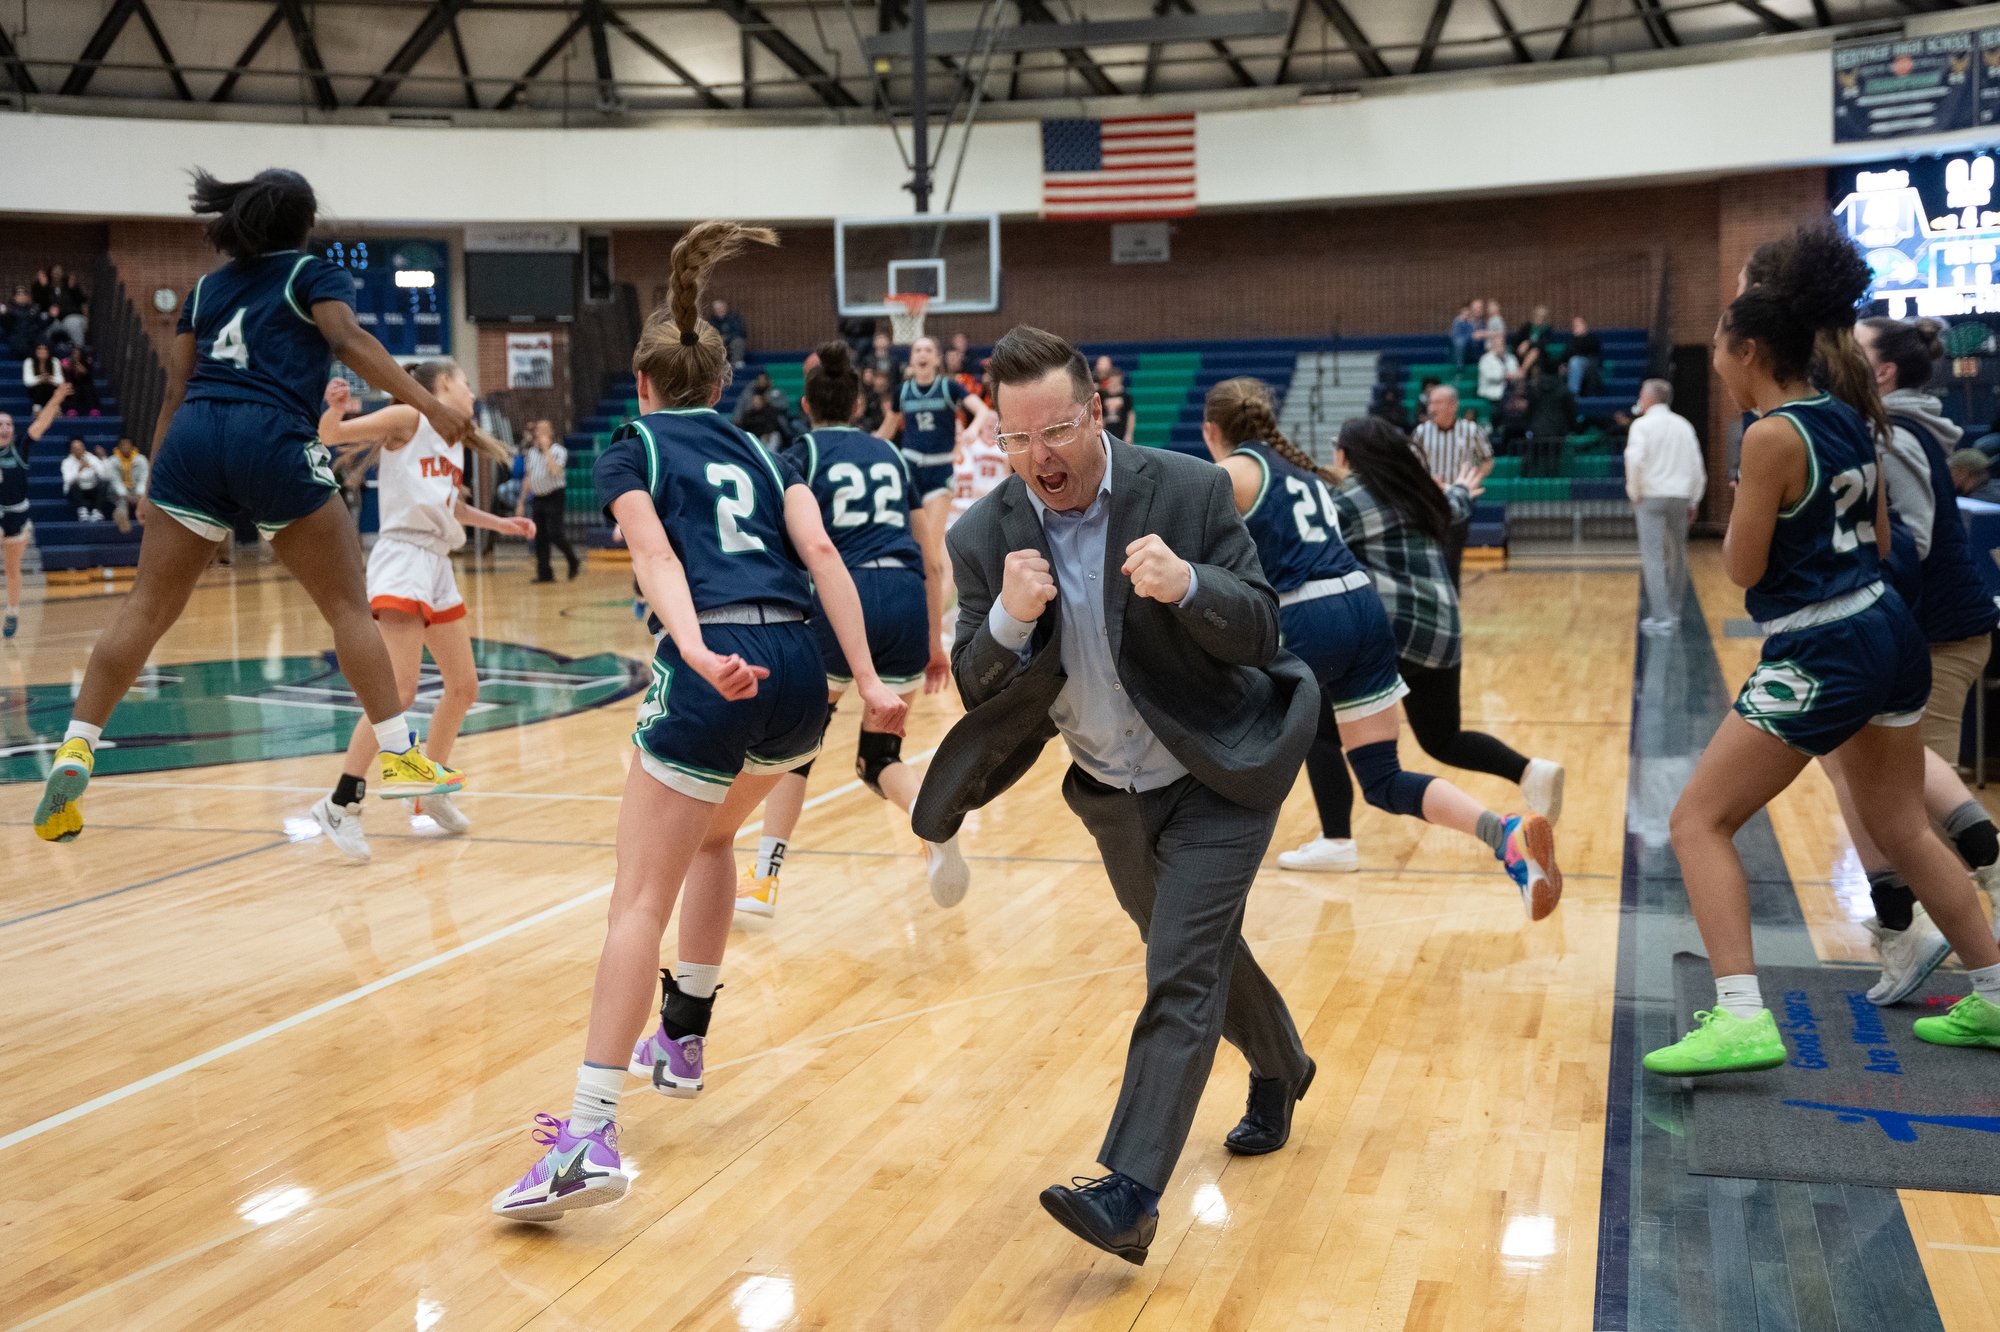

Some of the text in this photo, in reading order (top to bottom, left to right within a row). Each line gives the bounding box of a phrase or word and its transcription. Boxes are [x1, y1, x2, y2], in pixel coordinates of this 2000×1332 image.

[211, 307, 250, 370] 4
[915, 411, 936, 432] 12
[704, 462, 767, 555] 2
[827, 462, 906, 528] 22
[1285, 475, 1342, 543] 24
[1787, 1033, 1828, 1070] Good
[1864, 1049, 1904, 1075] Are
